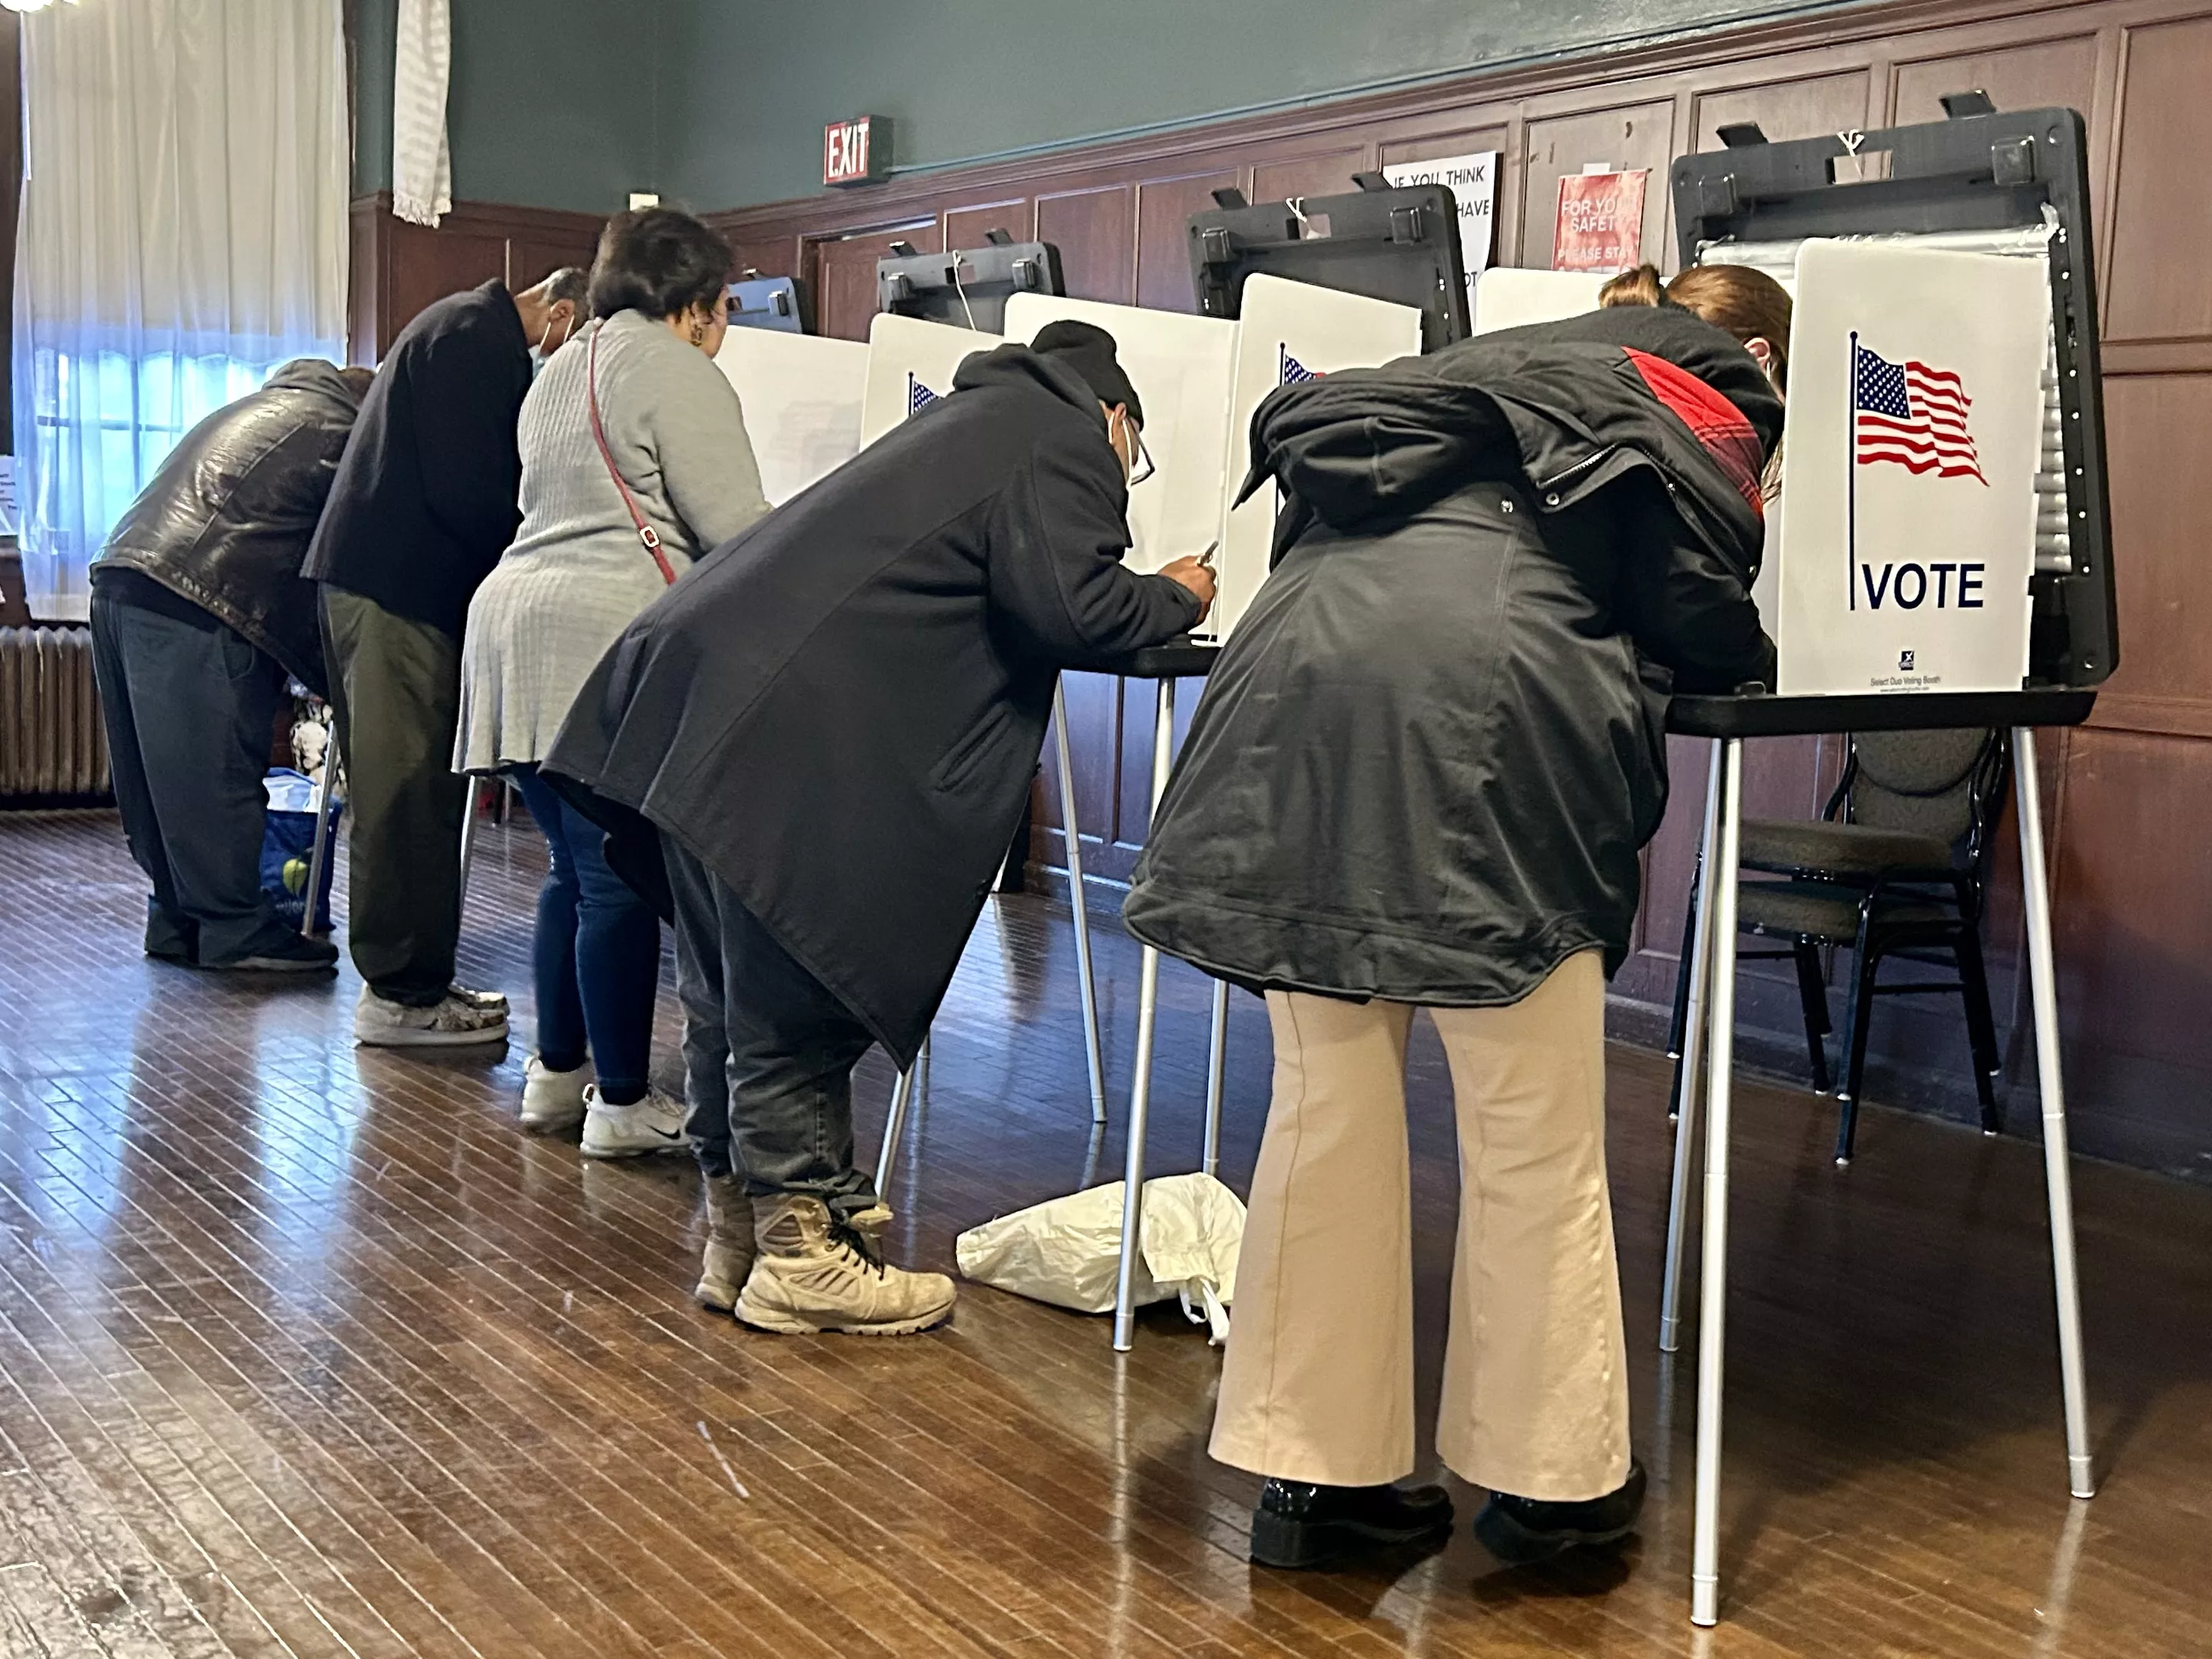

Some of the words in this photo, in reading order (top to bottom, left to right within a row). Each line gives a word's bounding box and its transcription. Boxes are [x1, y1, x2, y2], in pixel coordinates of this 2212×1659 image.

[828, 123, 869, 177] EXIT
[1411, 171, 1439, 185] YOU
[1446, 165, 1485, 186] THINK
[1456, 199, 1489, 218] HAVE
[1561, 200, 1591, 217] FOR
[1596, 197, 1619, 216] YO
[1571, 215, 1616, 233] SAFET
[1862, 563, 1985, 609] VOTE
